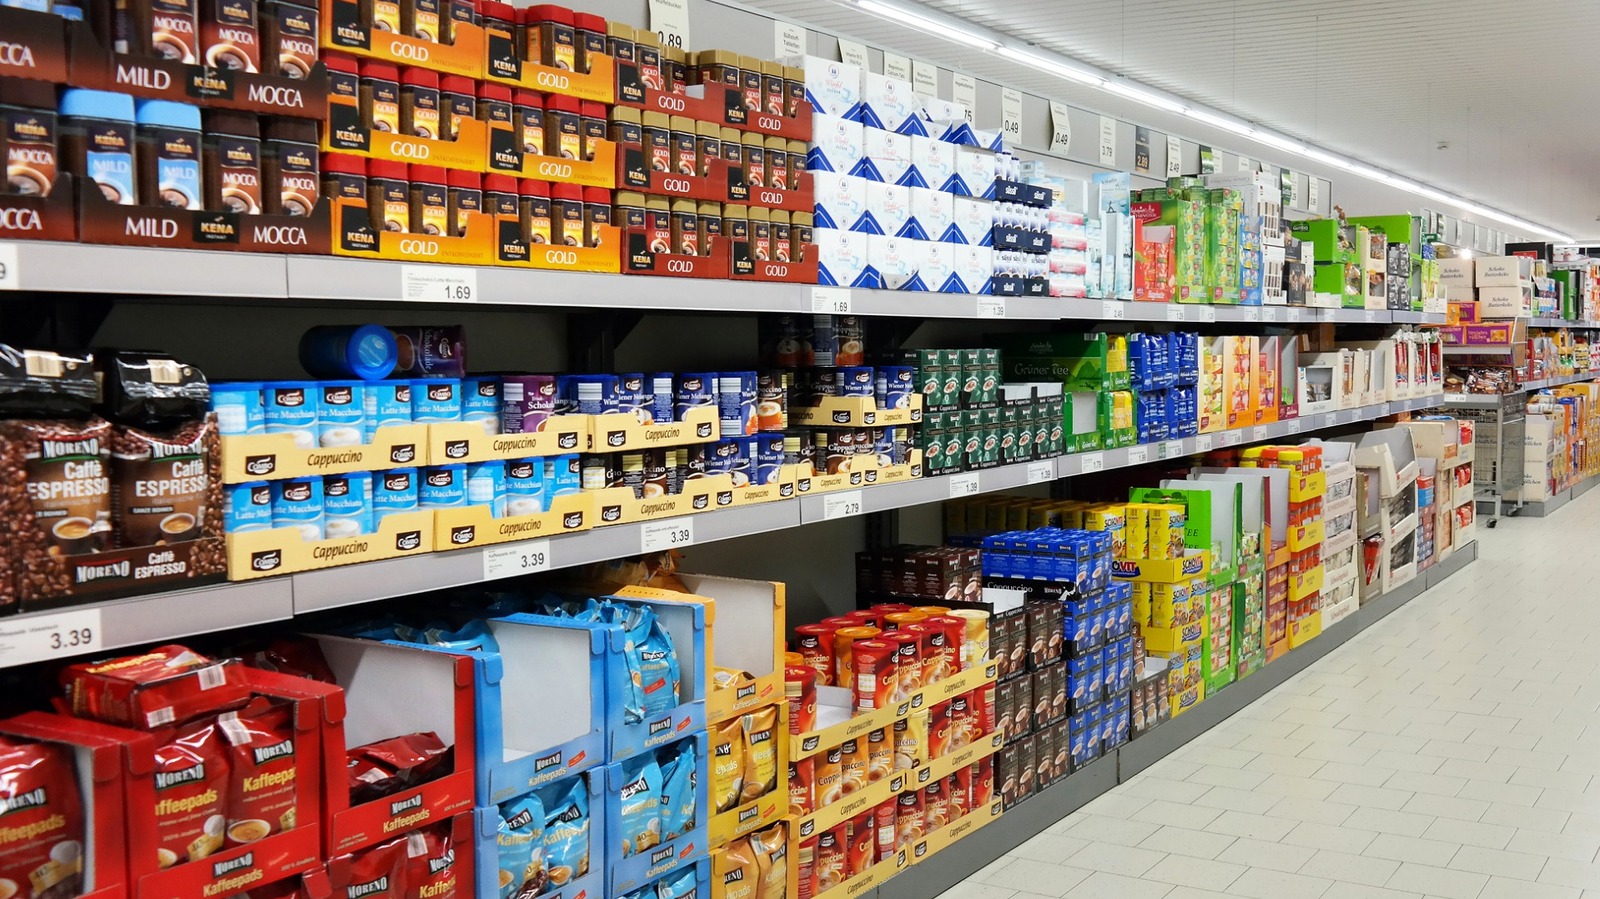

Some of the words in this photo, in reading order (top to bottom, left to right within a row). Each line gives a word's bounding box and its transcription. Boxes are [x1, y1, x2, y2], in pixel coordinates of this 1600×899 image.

[153, 16, 194, 34] MOCCA
[219, 28, 255, 45] MOCCA
[337, 26, 366, 42] KENA
[281, 39, 315, 56] MOCCA
[390, 41, 429, 62] GOLD
[493, 60, 517, 74] KENA
[116, 63, 172, 91] MILD
[193, 75, 228, 91] KENA
[537, 72, 569, 90] GOLD
[248, 83, 304, 108] MOCCA
[623, 86, 642, 98] KENA
[658, 95, 685, 112] GOLD
[728, 109, 744, 120] KENA
[758, 117, 781, 131] GOLD
[1004, 119, 1019, 134] 0.49
[336, 130, 365, 144] KENA
[1055, 132, 1068, 146] 0.49
[8, 147, 54, 165] MOCCA
[390, 141, 430, 160] GOLD
[495, 152, 519, 166] KENA
[539, 162, 572, 179] GOLD
[629, 171, 646, 182] KENA
[223, 172, 258, 187] MOCCA
[283, 177, 316, 191] MOCCA
[663, 178, 690, 193] GOLD
[731, 187, 746, 196] KENA
[760, 193, 783, 206] GOLD
[125, 216, 179, 239] MILD
[200, 222, 234, 236] KENA
[253, 225, 308, 246] MOCCA
[347, 231, 375, 246] KENA
[400, 239, 439, 256] GOLD
[503, 244, 526, 256] KENA
[546, 250, 577, 265] GOLD
[633, 255, 651, 265] KENA
[736, 260, 752, 270] KENA
[667, 259, 693, 273] GOLD
[765, 265, 787, 278] GOLD
[445, 285, 471, 299] 1.69
[833, 301, 848, 312] 1.69
[1014, 364, 1049, 375] Grüner
[1052, 364, 1069, 375] Tee
[645, 428, 680, 441] Cappuccino
[43, 438, 98, 458] MORENO
[493, 437, 536, 452] Cappuccino
[307, 451, 362, 468] Cappuccino
[64, 462, 102, 479] Caffè
[172, 461, 205, 478] Caffè
[821, 479, 842, 487] Cappuccino
[966, 482, 977, 493] 1.39
[744, 490, 769, 500] Cappuccino
[641, 502, 676, 516] Cappuccino
[845, 503, 859, 514] 2.79
[499, 520, 541, 535] Cappuccino
[1184, 528, 1198, 536] EE
[671, 529, 690, 543] 3.39
[313, 541, 368, 560] Cappuccino
[76, 563, 130, 582] MORENO
[148, 553, 174, 564] Caffè
[521, 552, 545, 568] 3.39
[1112, 559, 1136, 572] OVIT
[135, 563, 186, 579] ESPRESSO
[51, 628, 92, 649] 3.39
[944, 678, 966, 694] Cappuccino
[847, 720, 874, 736] Cappuccino
[644, 730, 676, 748] Kaffeepads
[255, 740, 293, 764] MORENO
[951, 749, 974, 766] Cappuccino
[535, 753, 560, 771] MORENO
[155, 763, 204, 790] MORENO
[243, 767, 296, 793] Kaffeepa
[528, 766, 567, 787] Kaffeepads
[155, 789, 218, 816] ffeepads
[392, 795, 422, 814] MORENO
[841, 797, 867, 816] Cappuccino
[383, 808, 430, 834] Kaffeepads
[949, 821, 972, 838] Cappuccino
[215, 853, 253, 875] MORENO
[646, 858, 679, 879] Kaffeepads
[203, 869, 263, 897] Kaffeepads
[347, 877, 387, 897] MORENO
[847, 875, 874, 895] Cappuccino
